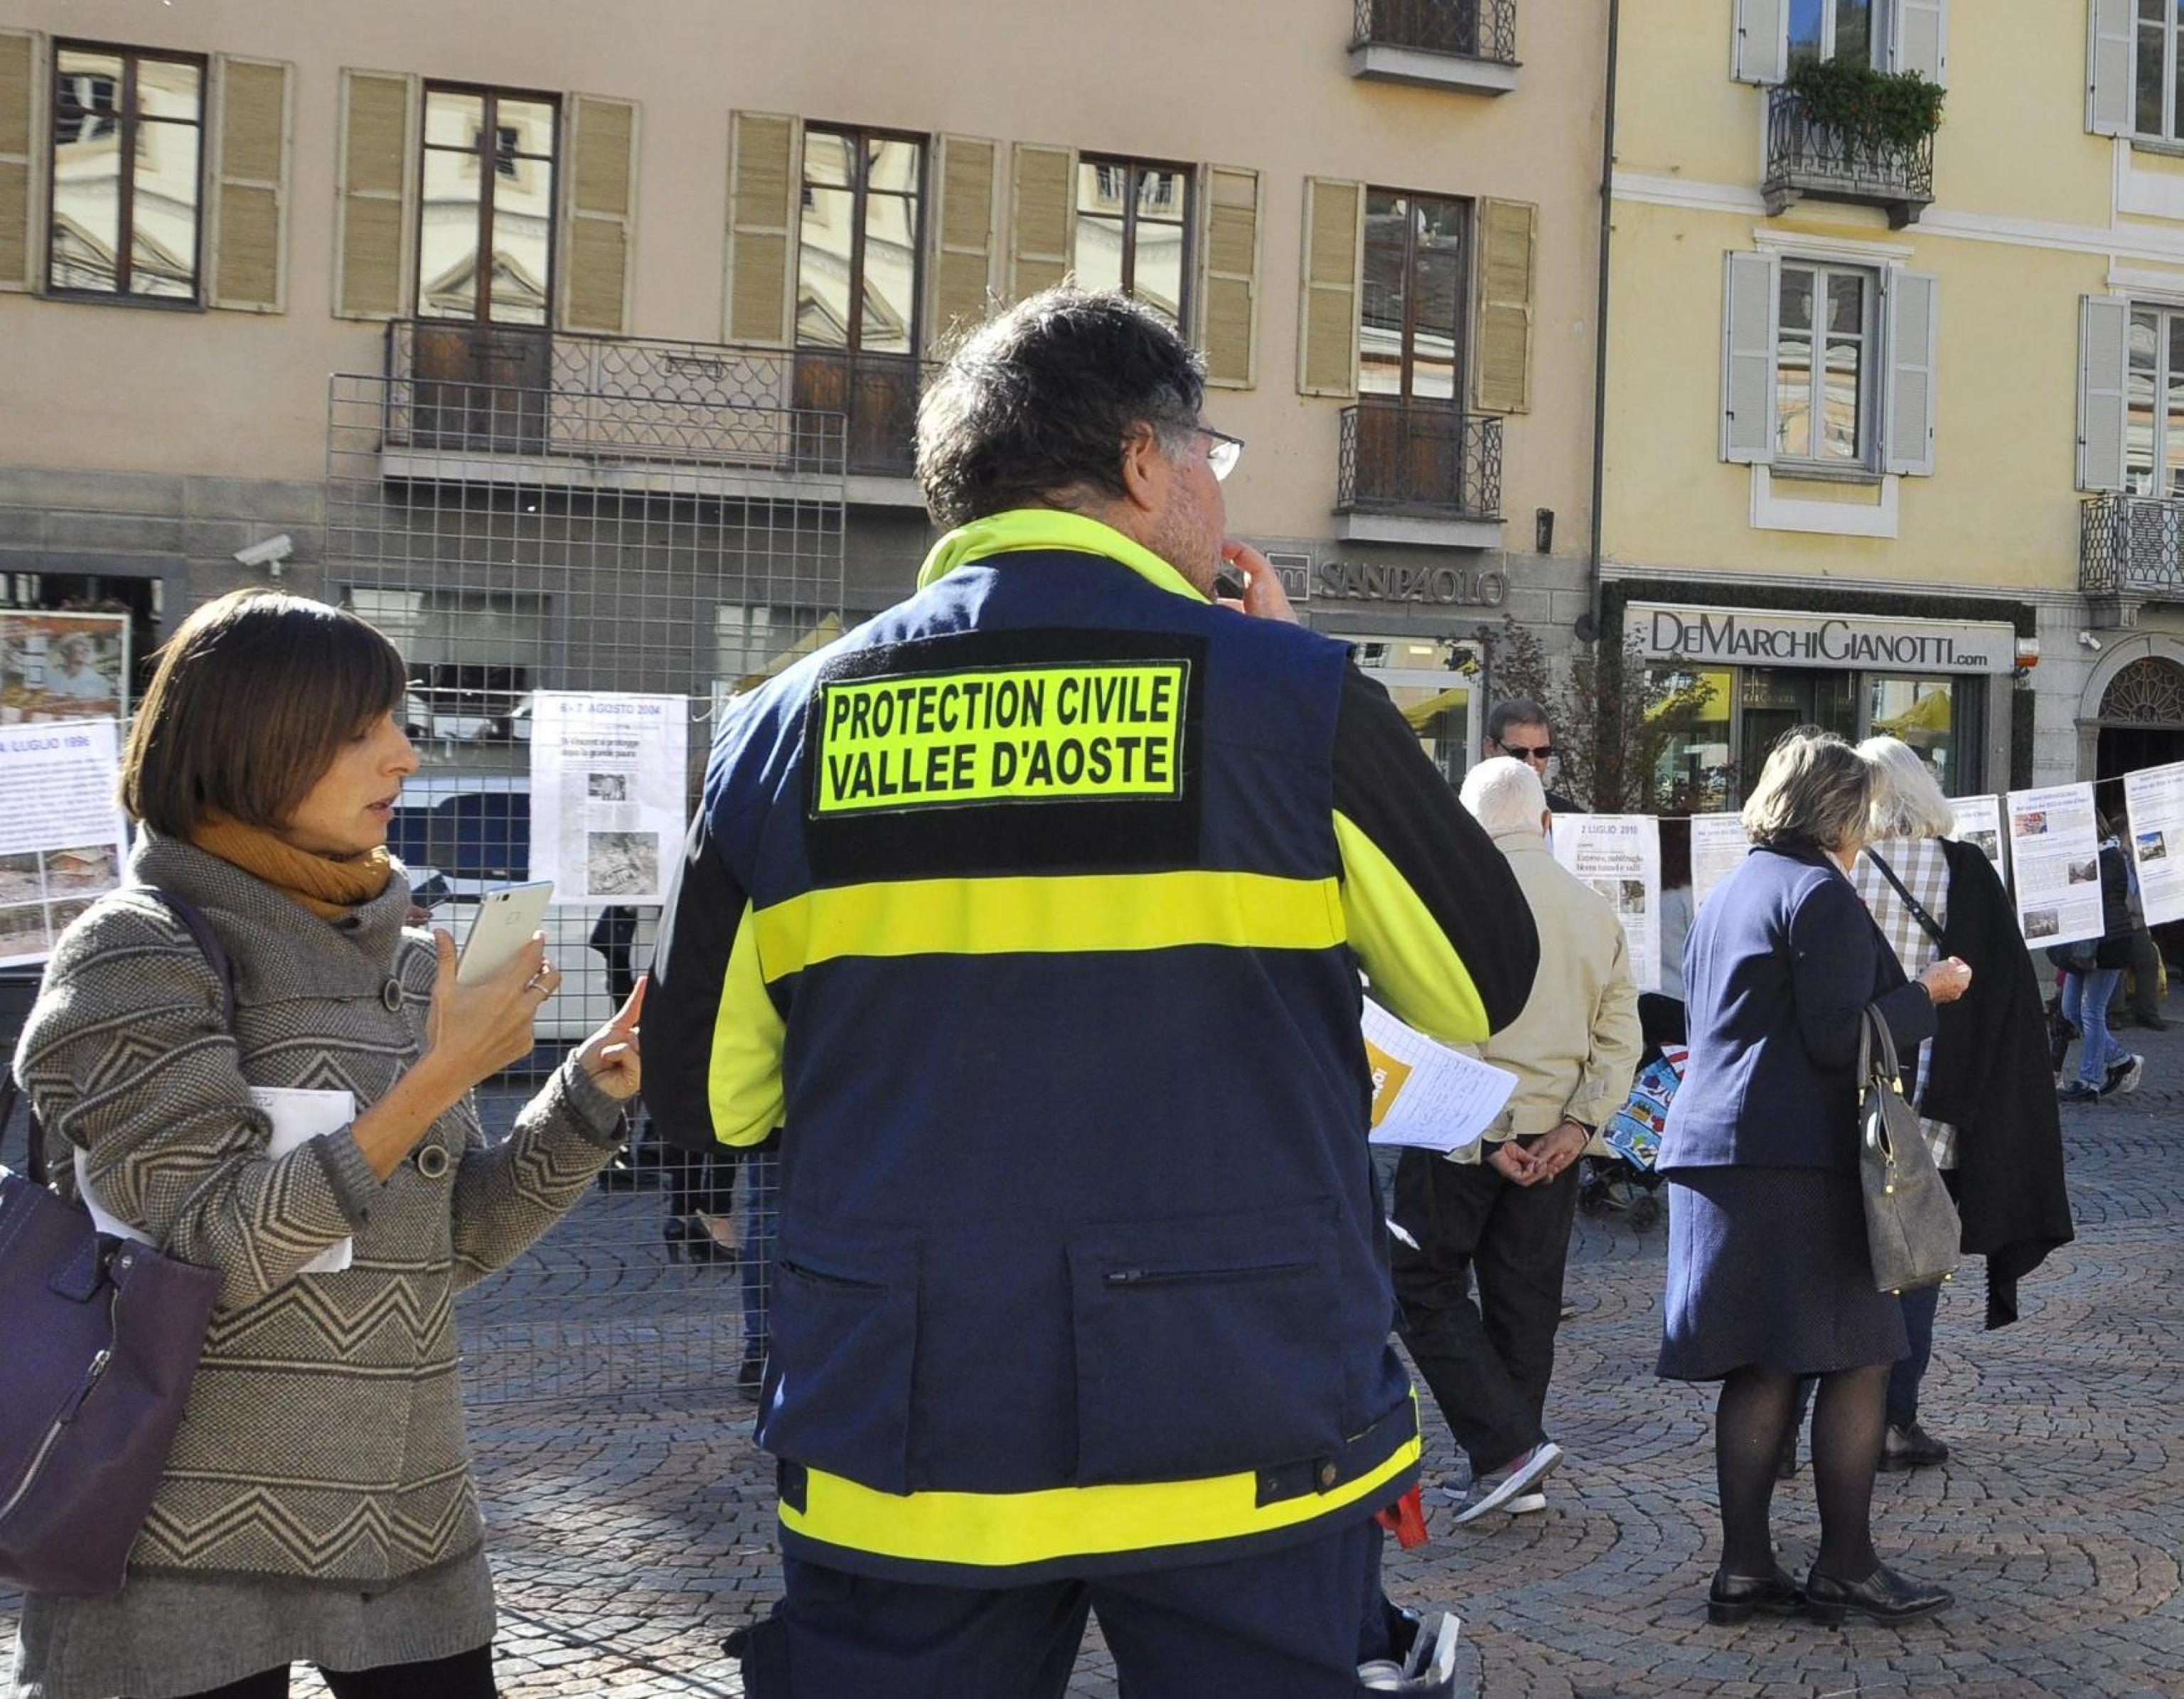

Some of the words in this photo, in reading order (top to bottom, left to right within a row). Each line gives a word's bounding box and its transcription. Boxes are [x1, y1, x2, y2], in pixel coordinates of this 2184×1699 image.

[1321, 561, 1509, 609] SANPAOLO
[588, 703, 634, 714] AGOSTO
[830, 678, 1044, 742] PROTECTION
[1057, 675, 1172, 726] CIVILE
[11, 737, 59, 752] LUGLIO
[828, 744, 977, 801] VALLEE
[991, 736, 1167, 788] D'AOSTE
[1588, 825, 1617, 834] LUGLIO
